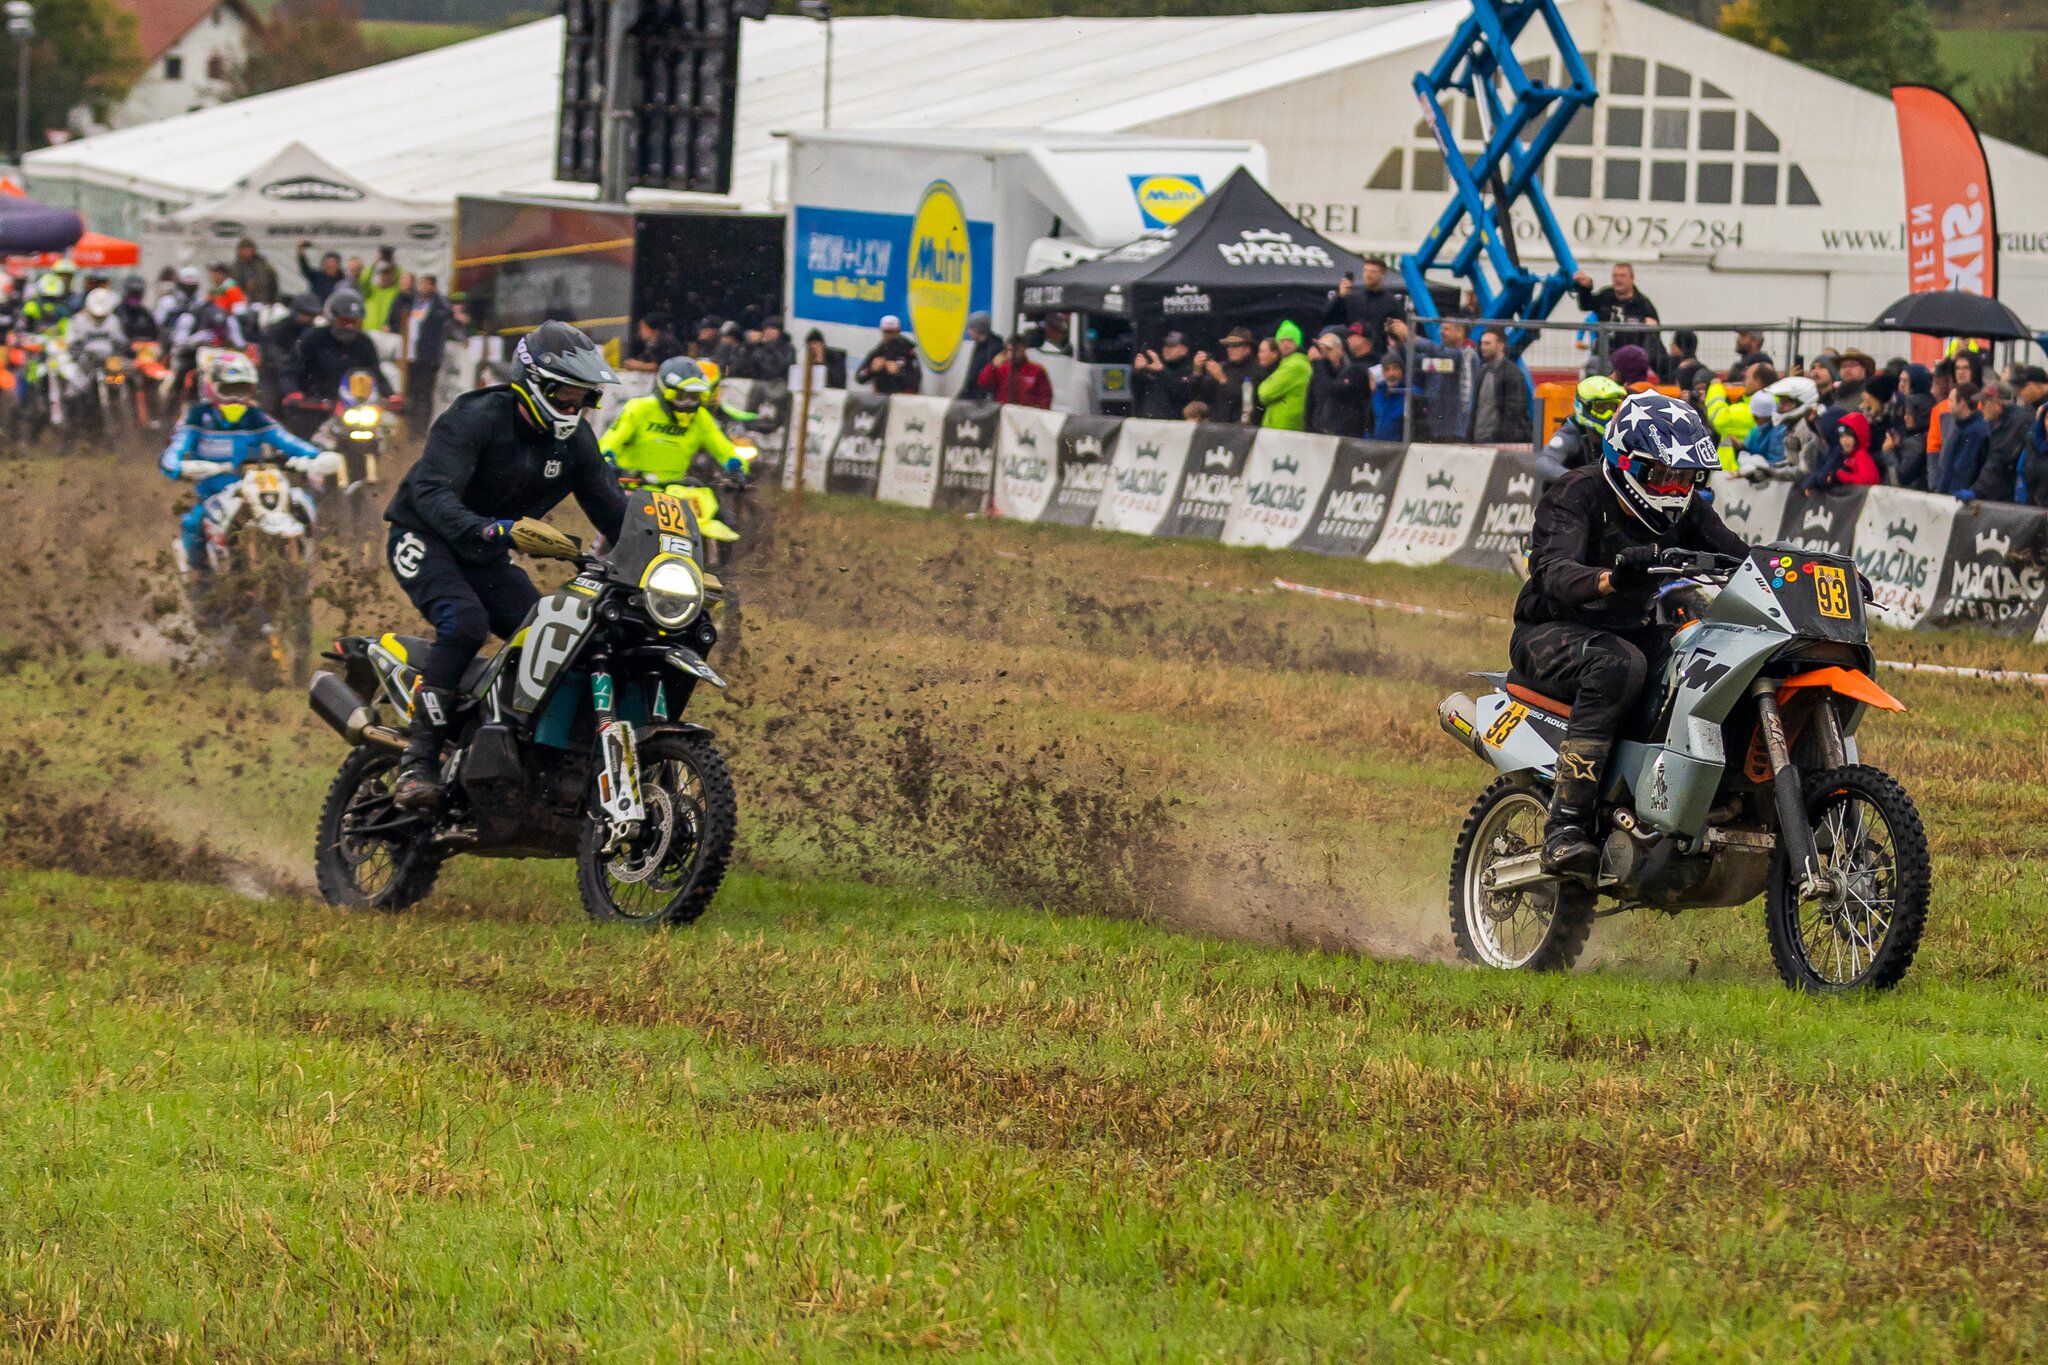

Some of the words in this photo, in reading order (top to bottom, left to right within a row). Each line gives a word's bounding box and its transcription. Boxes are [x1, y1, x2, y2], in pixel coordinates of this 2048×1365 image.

[1145, 189, 1198, 201] Muhr
[912, 235, 966, 285] Muhr
[657, 500, 684, 531] 92
[1323, 489, 1386, 523] MACIAG
[1396, 496, 1464, 528] MACIAG
[660, 535, 693, 557] 12
[1855, 545, 1929, 588] MACIAG
[1949, 559, 2046, 602] MACIAG
[1817, 576, 1848, 614] 93
[1485, 710, 1522, 745] 93
